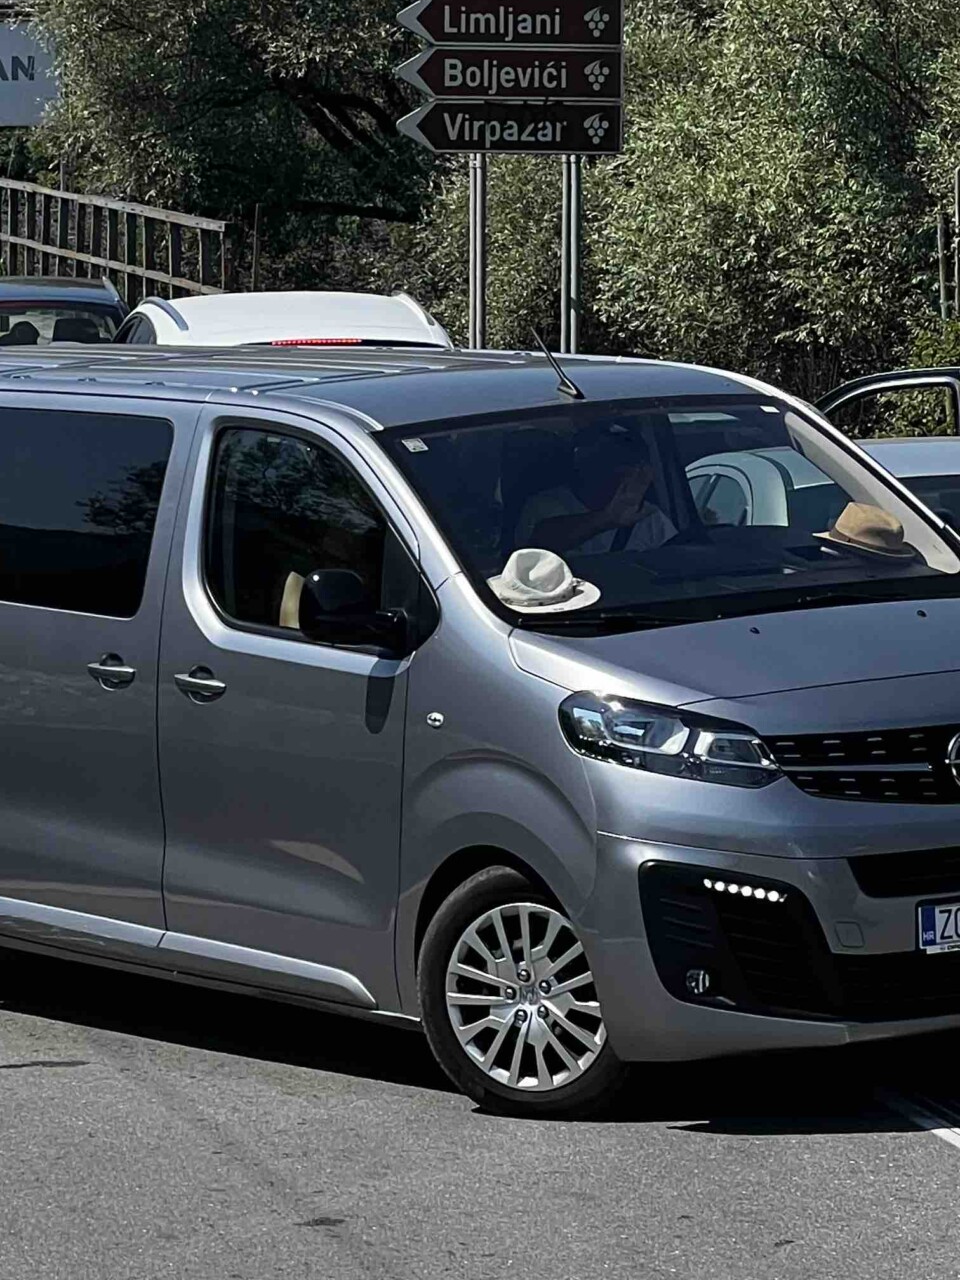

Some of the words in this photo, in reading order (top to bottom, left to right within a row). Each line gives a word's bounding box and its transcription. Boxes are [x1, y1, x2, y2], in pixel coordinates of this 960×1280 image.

[444, 5, 560, 41] Limljani
[444, 58, 567, 95] Boljevići
[443, 113, 567, 148] Virpazar
[922, 931, 935, 941] HR
